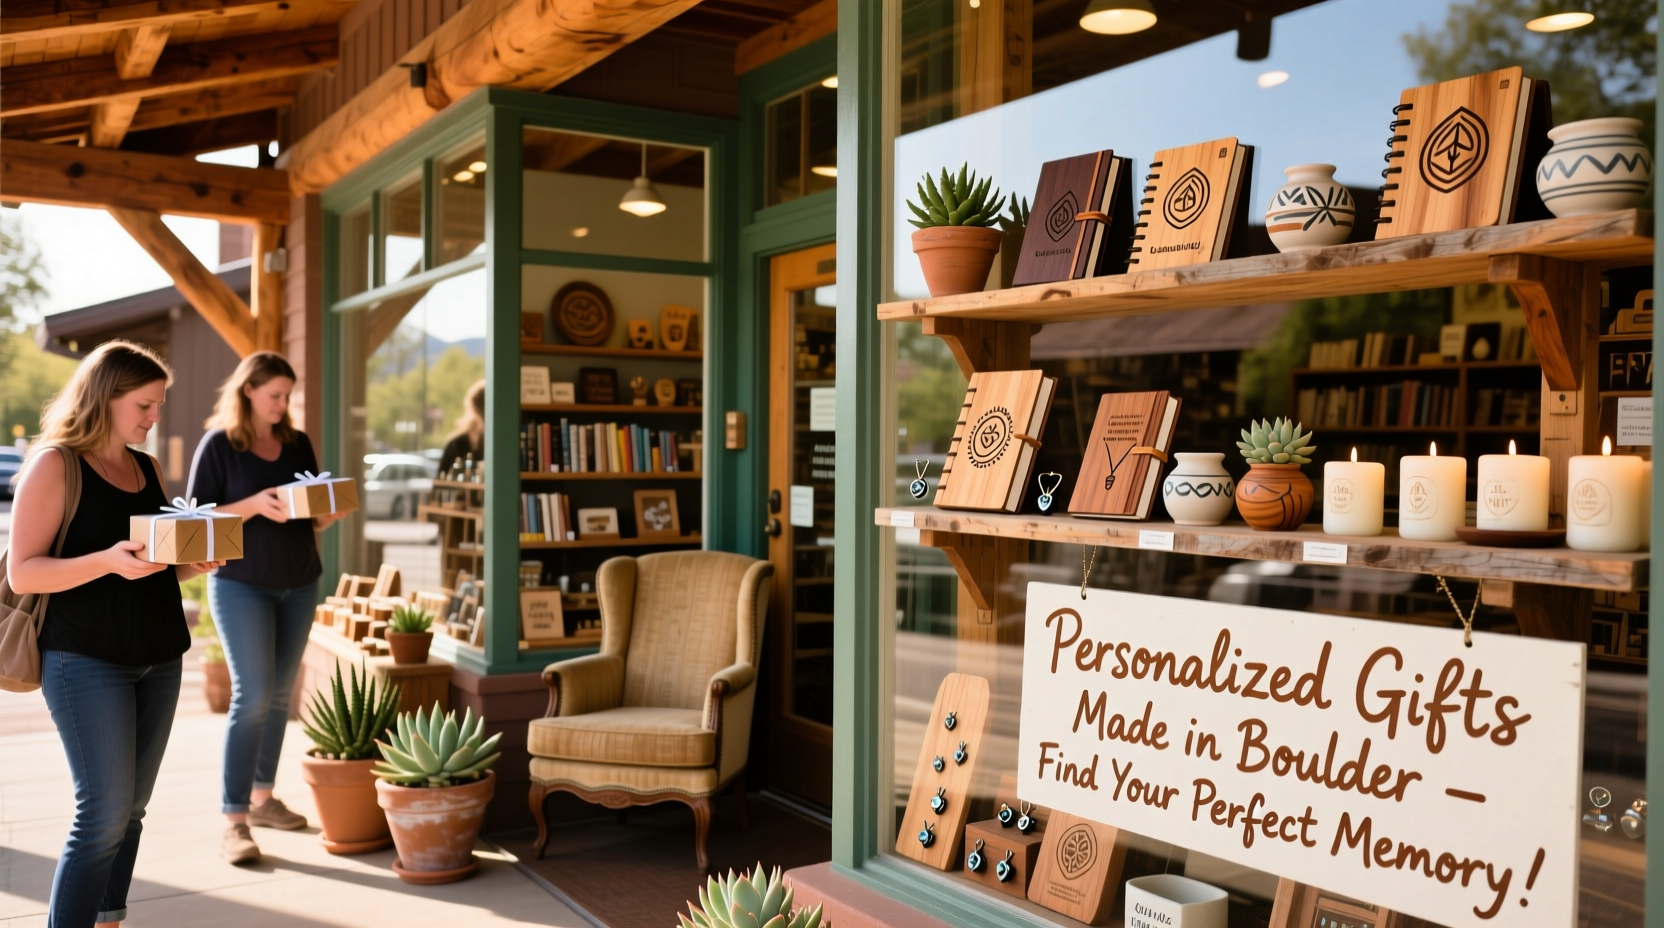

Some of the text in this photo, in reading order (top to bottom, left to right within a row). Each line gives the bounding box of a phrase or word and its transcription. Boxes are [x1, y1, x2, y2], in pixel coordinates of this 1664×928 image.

[1045, 607, 1532, 755] Personalized Gifts
[1072, 689, 1170, 751] Made
[1184, 717, 1222, 762] in
[1236, 718, 1423, 803] Boulder
[1038, 741, 1546, 920] Find Your Perfect Memory!
